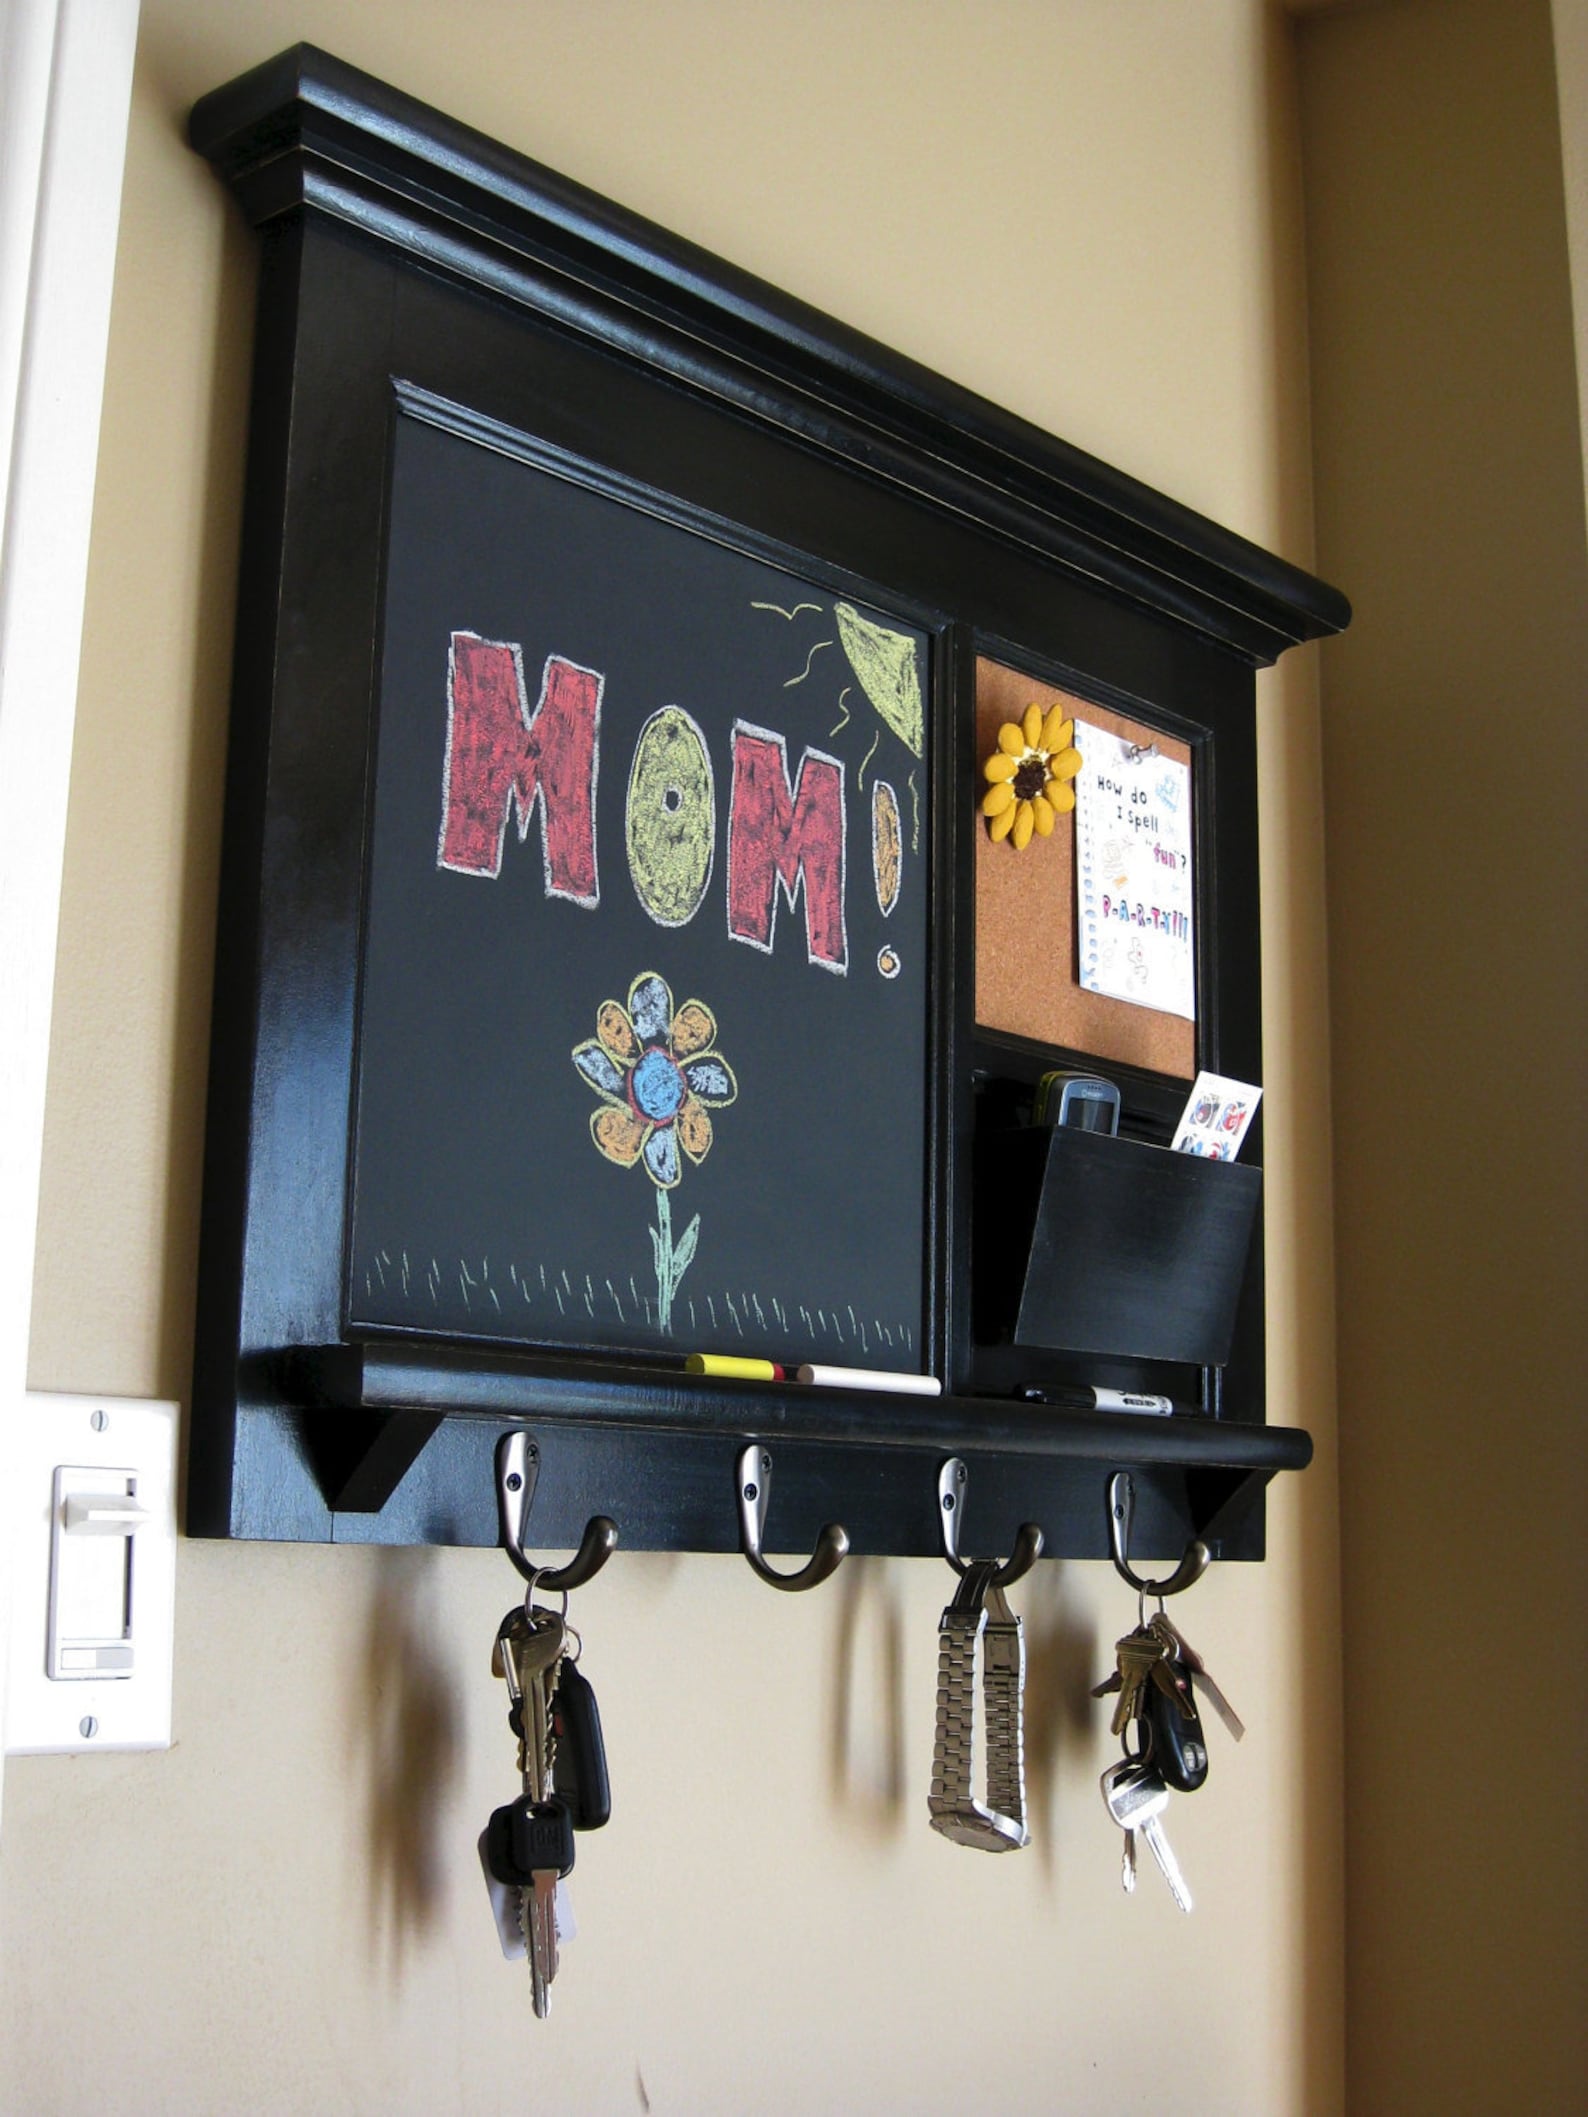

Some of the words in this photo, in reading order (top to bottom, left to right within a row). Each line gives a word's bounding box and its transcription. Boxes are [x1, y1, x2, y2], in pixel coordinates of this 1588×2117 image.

[437, 629, 901, 979] MOM!
[1097, 775, 1122, 796] How
[1131, 786, 1147, 804] do
[1117, 805, 1122, 819] I
